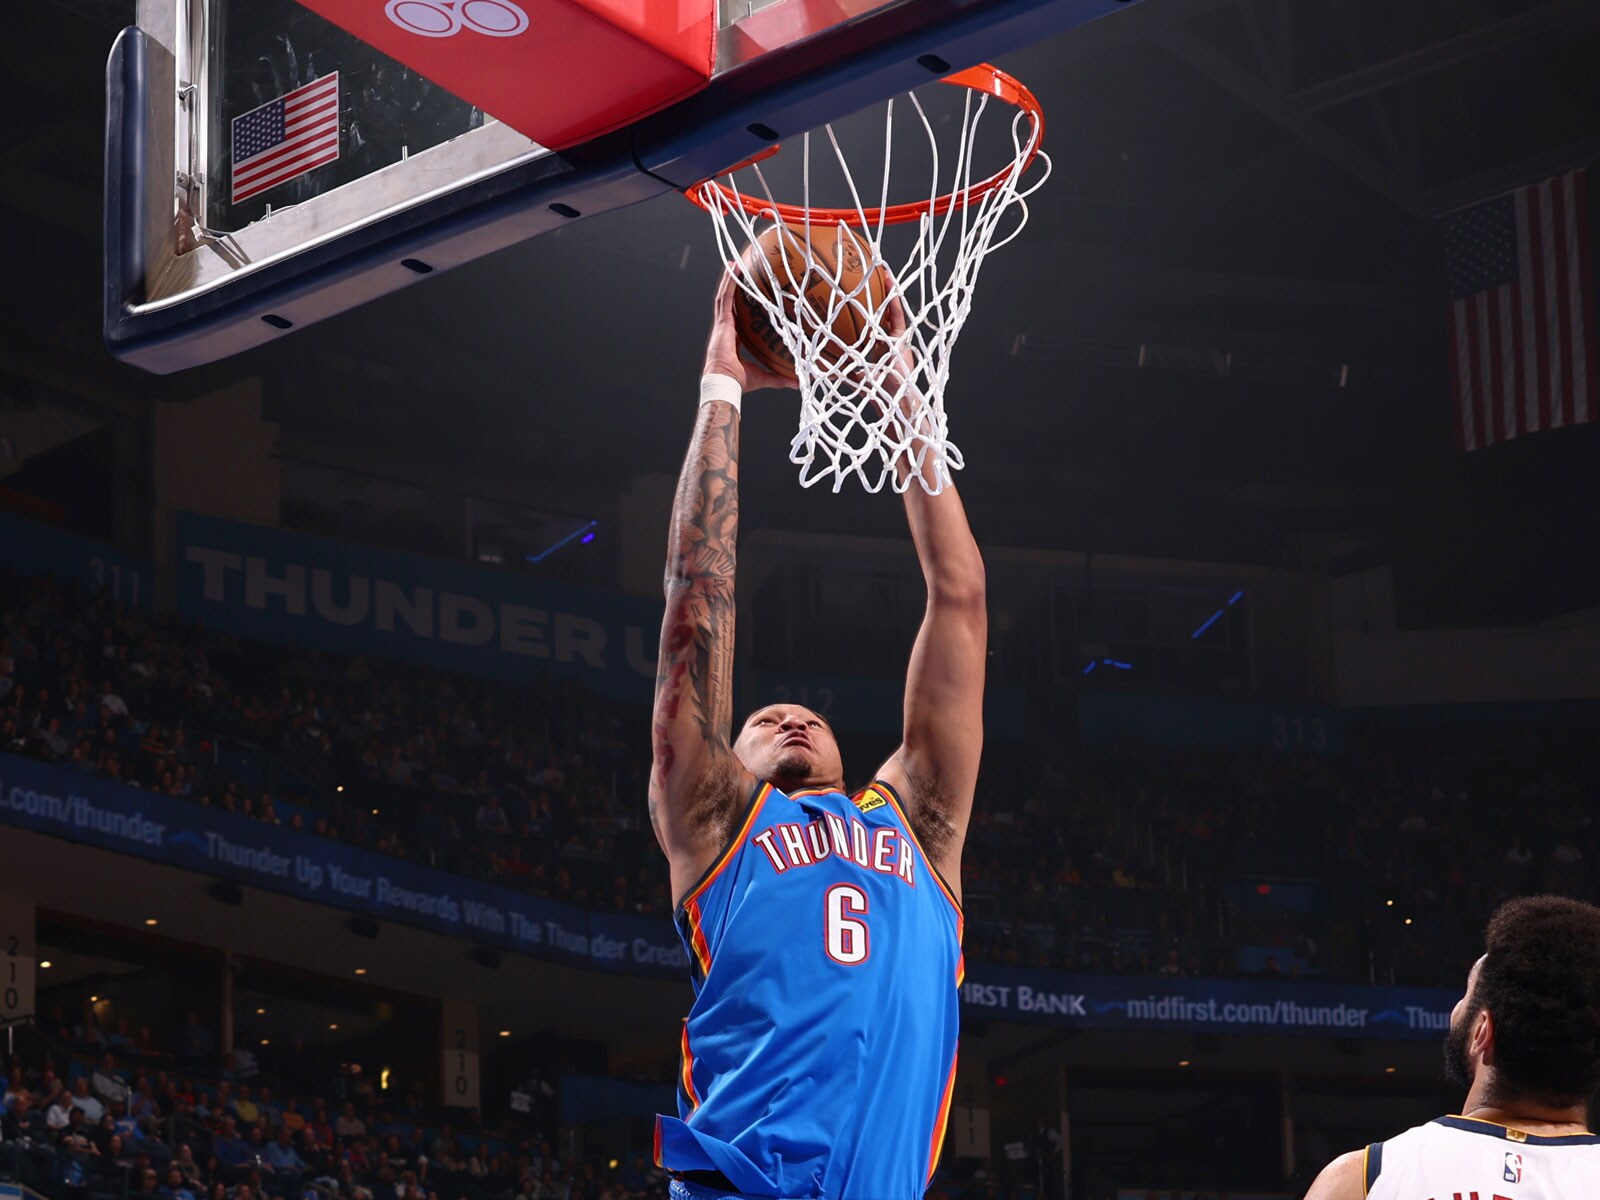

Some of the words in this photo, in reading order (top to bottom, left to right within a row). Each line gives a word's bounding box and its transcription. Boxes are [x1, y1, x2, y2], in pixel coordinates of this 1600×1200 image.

[187, 545, 608, 667] THUNDER
[1271, 716, 1328, 751] 313
[752, 811, 915, 888] THUNDER
[205, 831, 290, 878] Thunder
[296, 855, 324, 888] Up
[327, 863, 371, 898] Your
[376, 876, 460, 923] Rewards
[464, 899, 505, 934] With
[508, 911, 543, 943] The
[546, 921, 626, 959] Thunder
[824, 882, 870, 965] 6
[962, 982, 1011, 1007] IRST
[1017, 985, 1087, 1016] BANK
[1126, 994, 1368, 1028] midfirst.com/thunder
